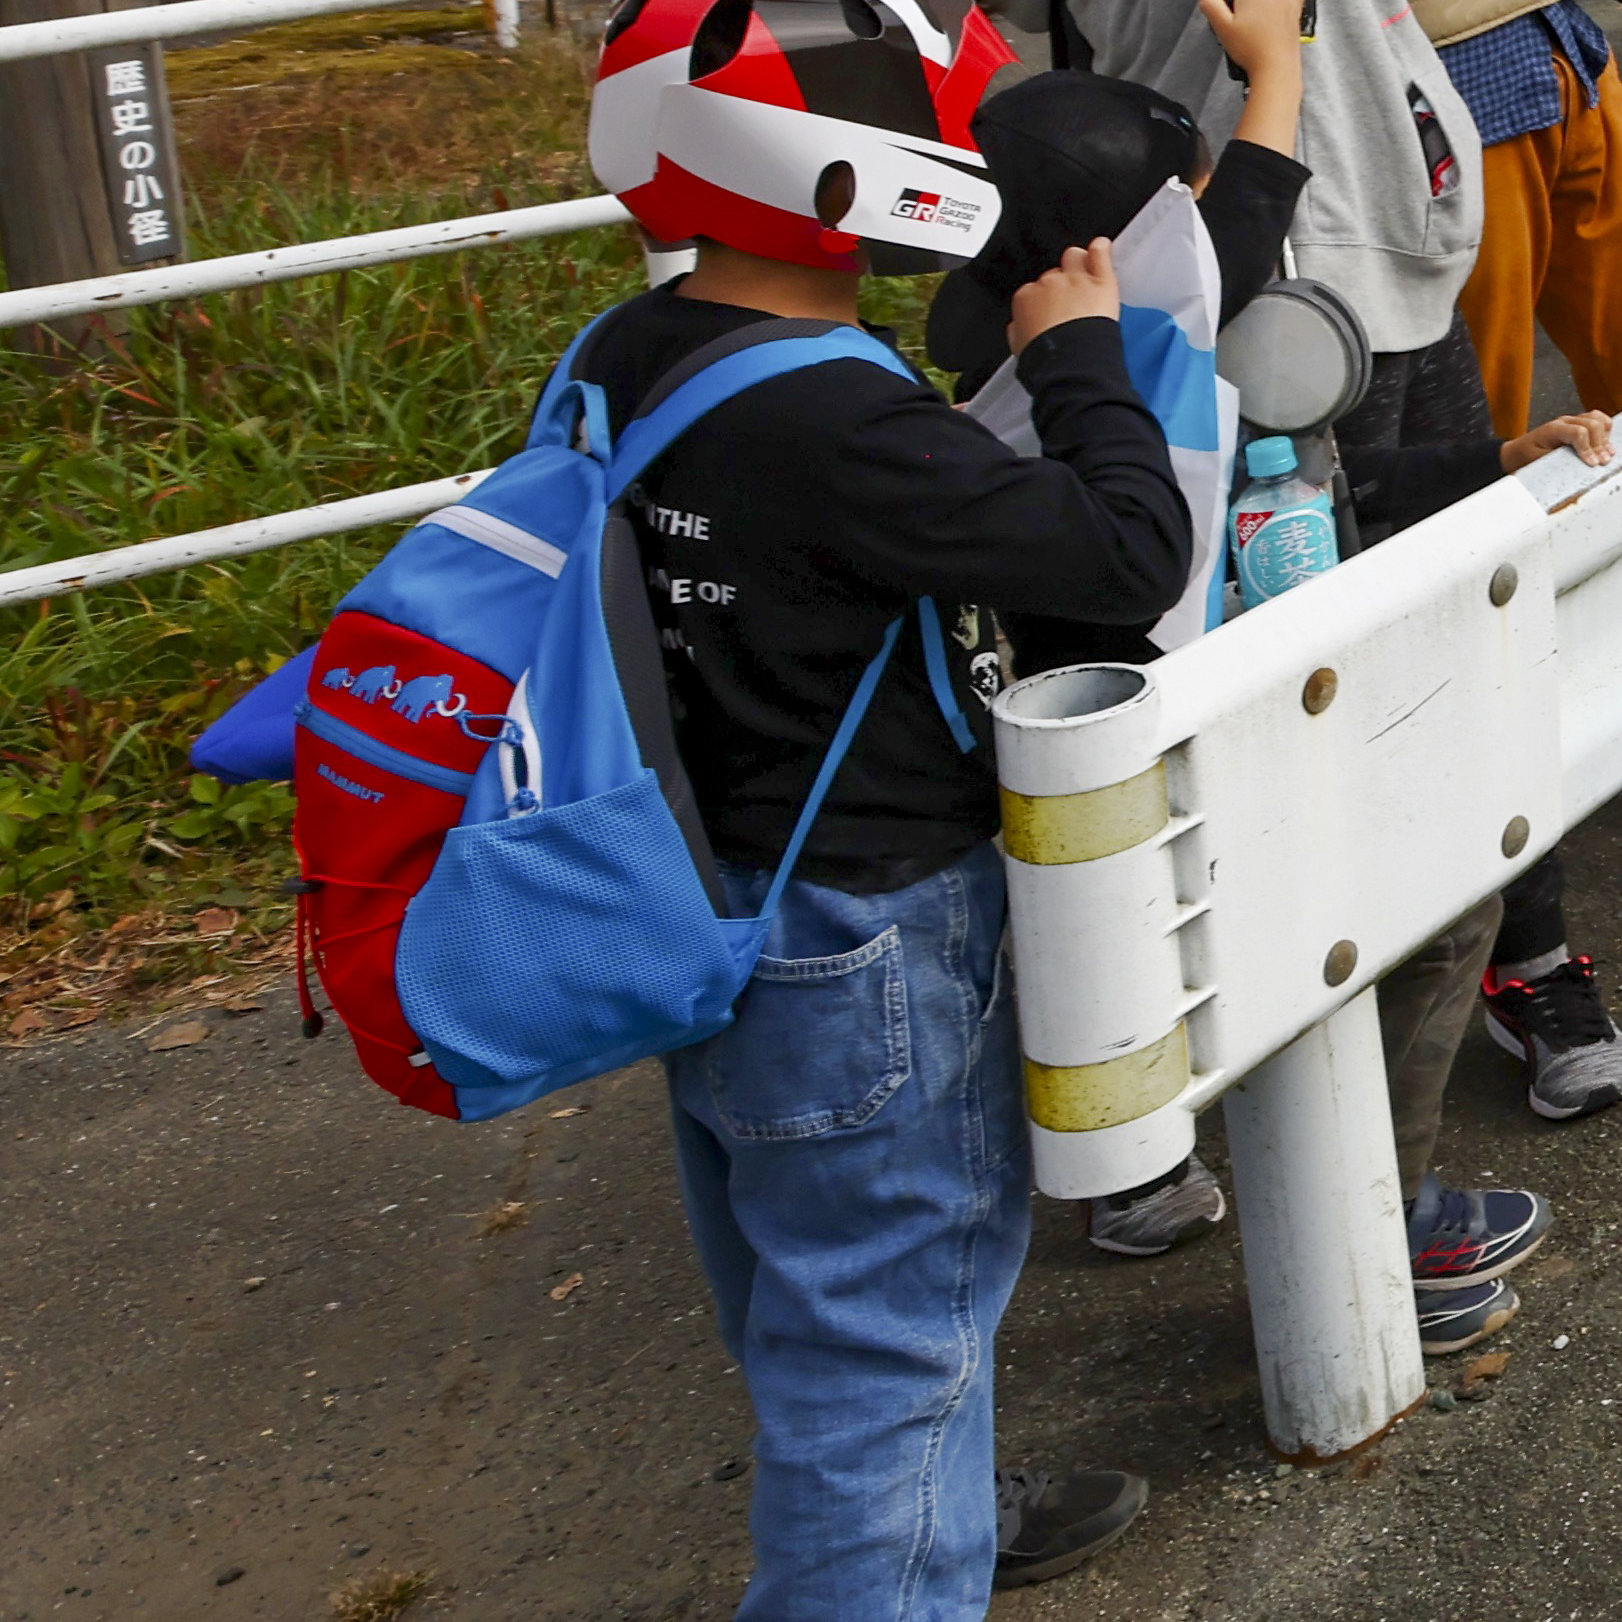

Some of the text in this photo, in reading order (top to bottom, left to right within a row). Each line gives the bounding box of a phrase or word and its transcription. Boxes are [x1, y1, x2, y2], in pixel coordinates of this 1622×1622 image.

[105, 60, 171, 246] 歴史の小径
[892, 198, 937, 222] GR
[940, 206, 976, 221] GAZOO
[943, 196, 982, 212] TOYOTA
[936, 216, 972, 232] Racing
[697, 581, 738, 607] OF
